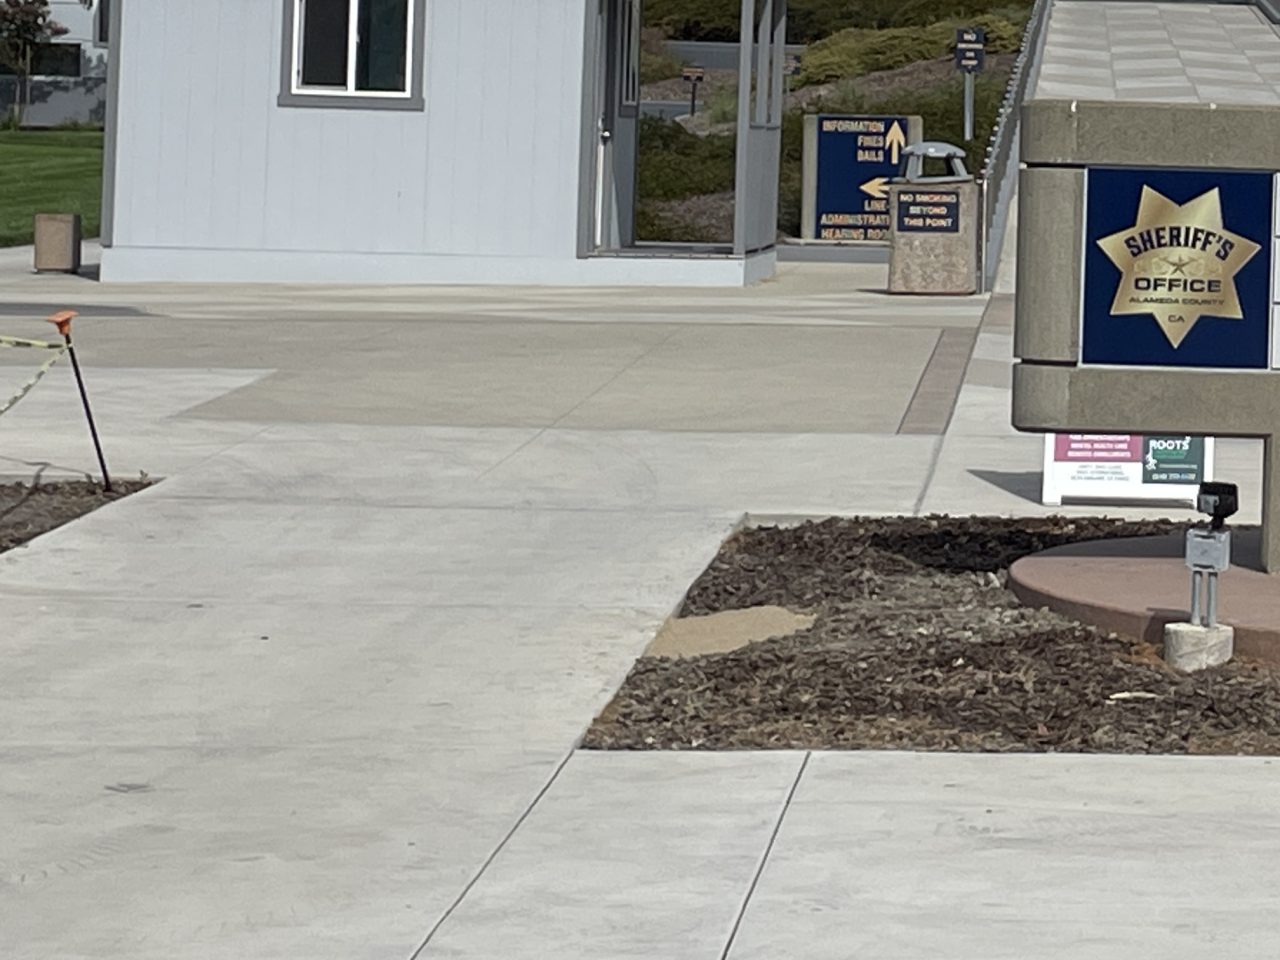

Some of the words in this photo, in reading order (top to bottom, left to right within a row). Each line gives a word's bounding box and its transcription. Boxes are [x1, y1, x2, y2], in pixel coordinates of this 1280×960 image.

[822, 120, 885, 133] INFORMATION
[900, 193, 914, 202] NO
[915, 193, 957, 203] SMOKING
[909, 206, 948, 215] BEYOND
[820, 213, 890, 225] ADMINISTRATI
[903, 217, 924, 227] THIS
[925, 218, 953, 227] POINT
[821, 228, 865, 240] HEARING
[1124, 226, 1235, 261] SHERIFF'S
[1134, 277, 1222, 293] OFFICE
[1129, 296, 1180, 305] ALAMEDA
[1181, 297, 1225, 306] COUNTY
[1167, 314, 1185, 323] CA
[1149, 437, 1190, 450] ROOTS
